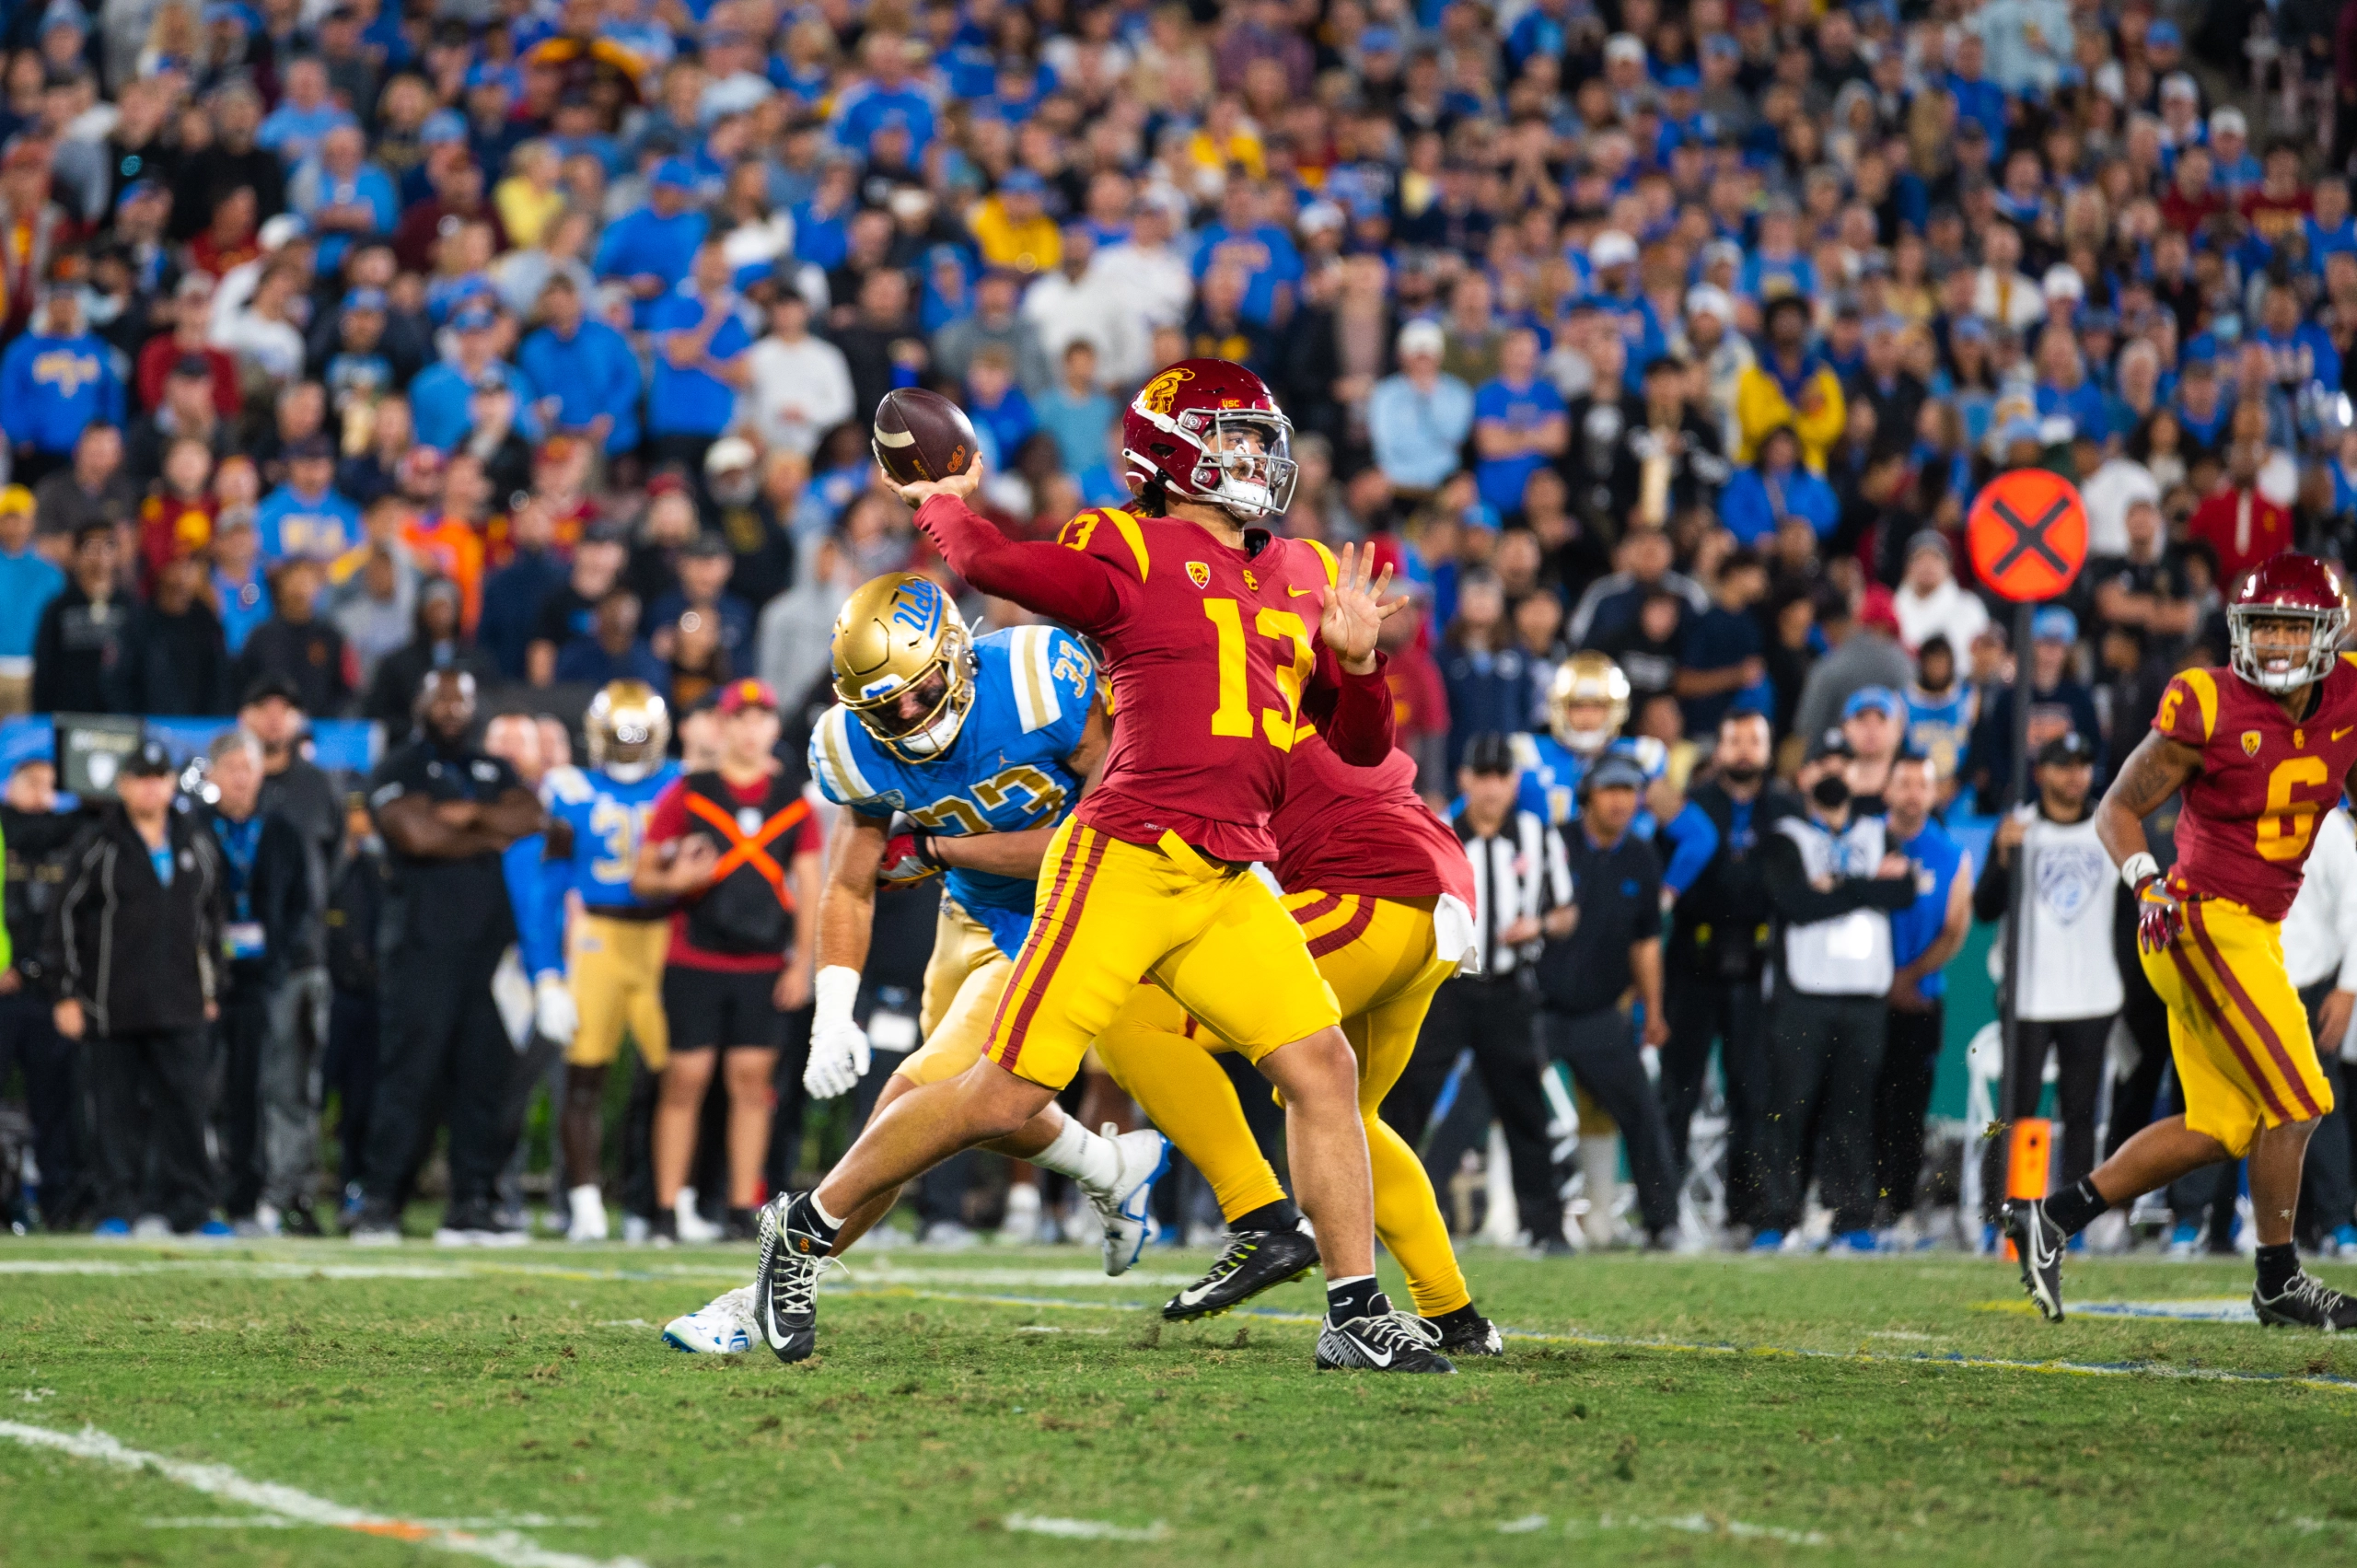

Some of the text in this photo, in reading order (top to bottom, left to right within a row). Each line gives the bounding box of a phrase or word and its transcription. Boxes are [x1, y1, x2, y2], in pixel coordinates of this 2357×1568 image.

[1222, 400, 1240, 408] USC
[1052, 640, 1092, 699] 33
[1202, 598, 1315, 753] 13
[2160, 690, 2184, 732] 6
[2256, 755, 2328, 862] 6
